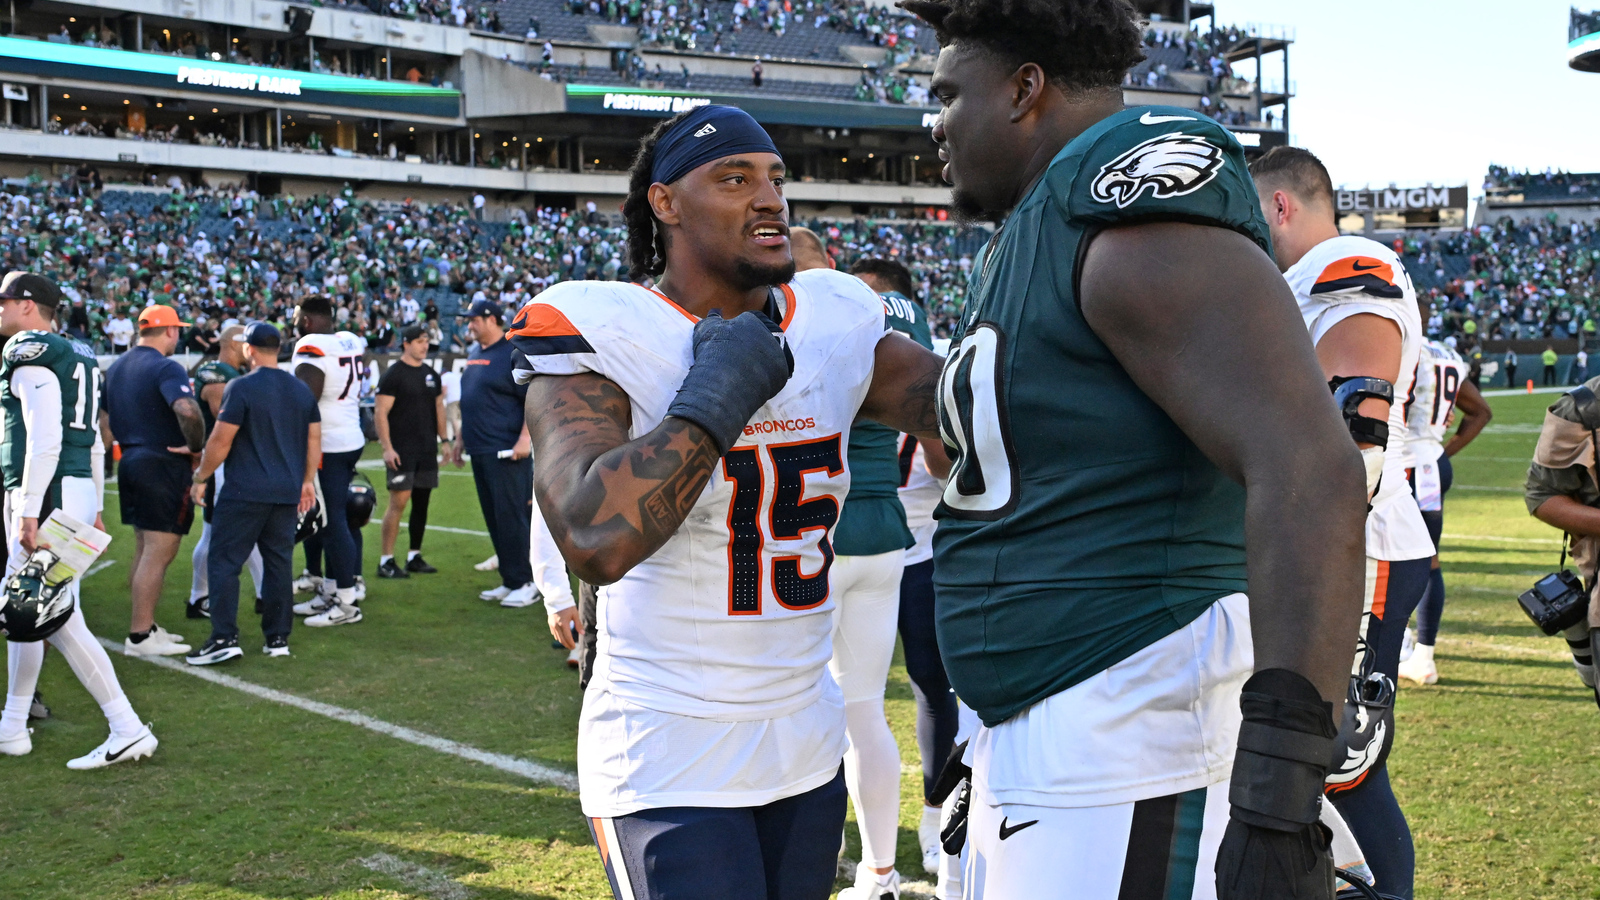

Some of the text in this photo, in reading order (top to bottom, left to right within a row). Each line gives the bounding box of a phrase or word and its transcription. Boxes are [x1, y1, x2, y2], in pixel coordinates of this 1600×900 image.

[258, 75, 302, 95] BANK
[1337, 188, 1450, 210] BETMGM
[1430, 364, 1460, 427] 19
[743, 417, 815, 436] BRONCOS
[722, 432, 845, 616] 15
